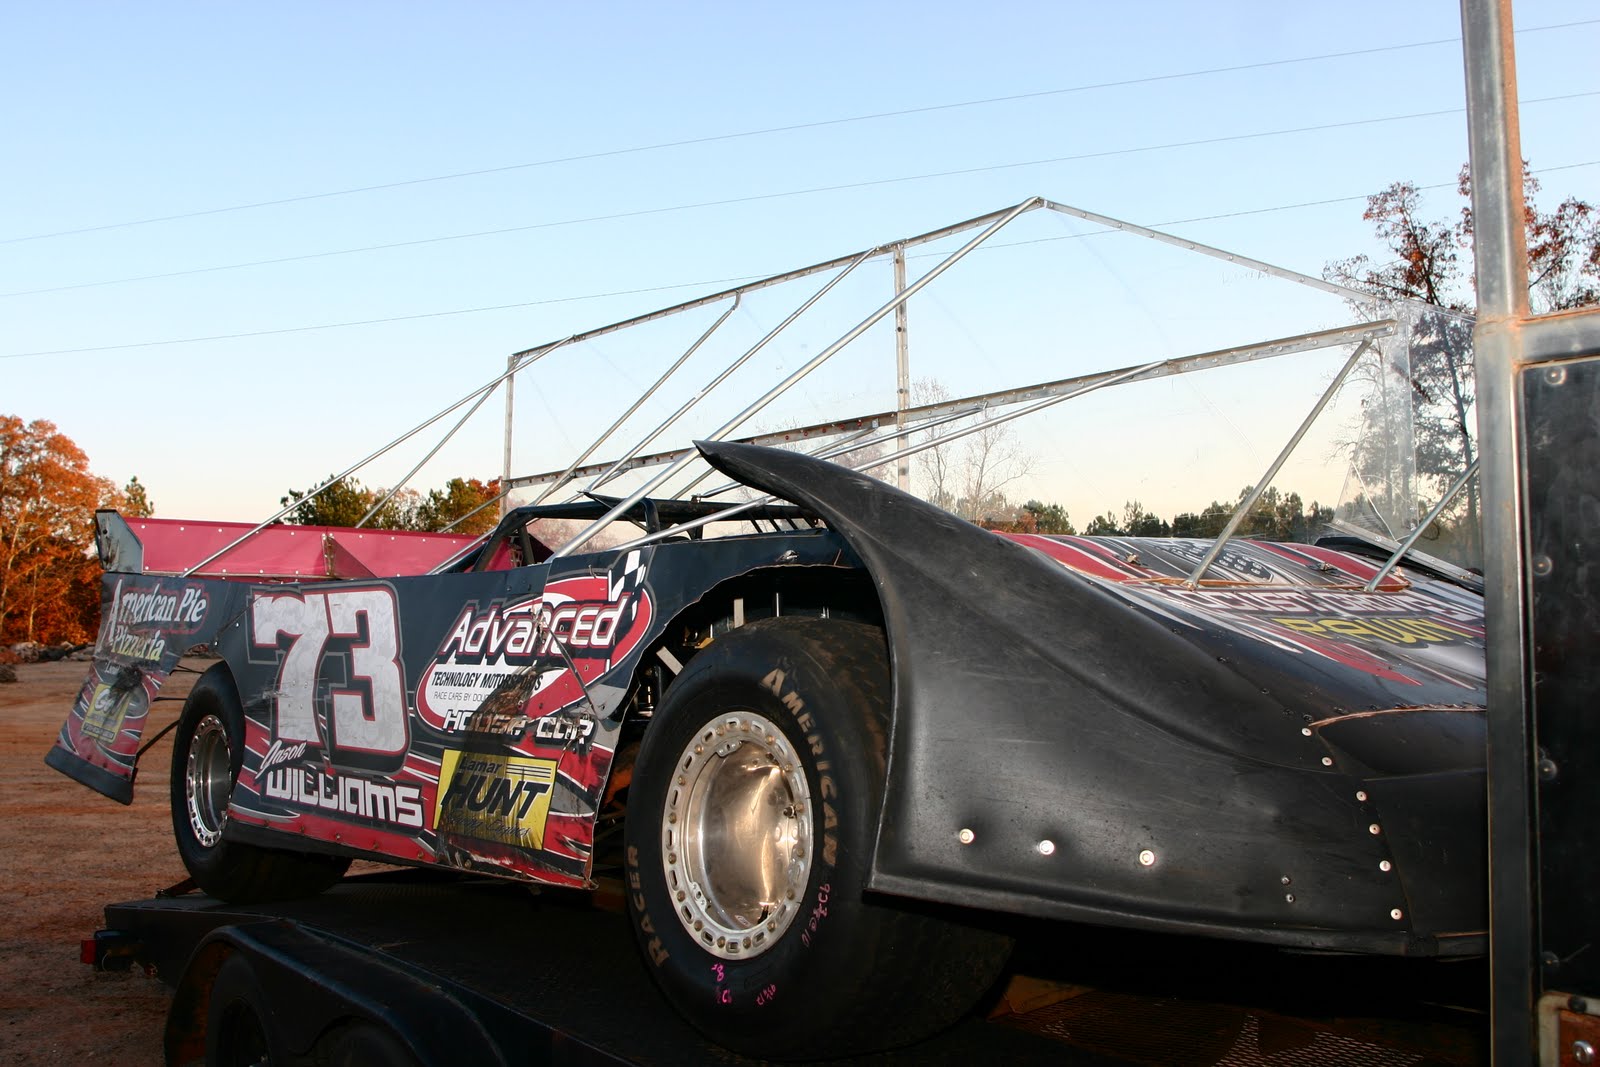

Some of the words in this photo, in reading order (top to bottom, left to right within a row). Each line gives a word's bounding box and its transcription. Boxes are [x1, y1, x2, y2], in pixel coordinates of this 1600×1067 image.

[97, 579, 176, 653] American
[174, 588, 207, 623] Pie
[1271, 617, 1474, 644] PAWN
[110, 624, 166, 662] Pizzeria
[252, 589, 407, 753] 73
[432, 671, 481, 688] TECHNOLOGY
[433, 690, 447, 700] RACE
[448, 691, 462, 701] CARS
[463, 692, 471, 701] BY
[255, 739, 307, 779] Jason
[459, 756, 503, 774] Lamar
[759, 667, 838, 867] AMERICAN
[265, 767, 425, 828] WILLIAMS
[441, 771, 551, 820] HUNT
[627, 846, 671, 968] RACER
